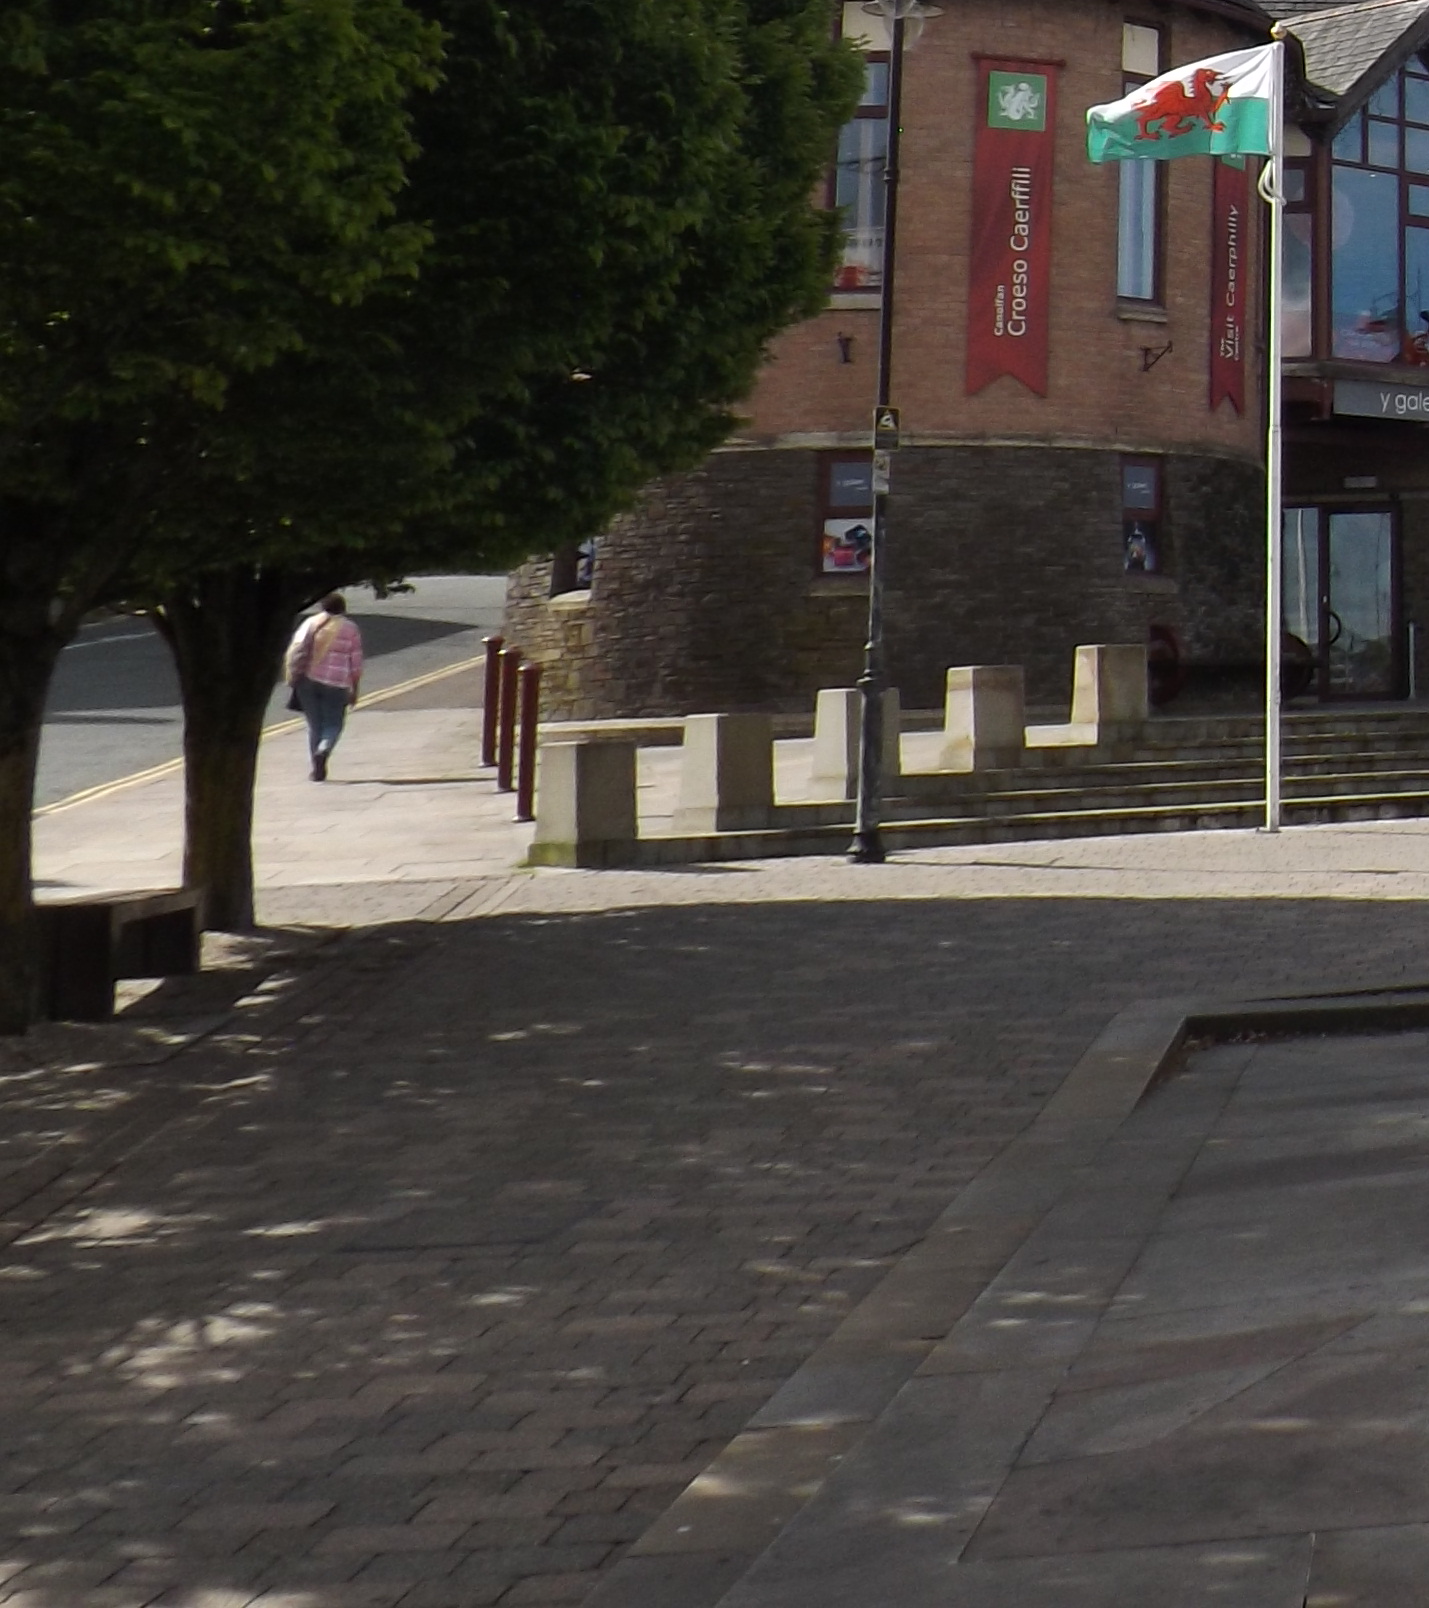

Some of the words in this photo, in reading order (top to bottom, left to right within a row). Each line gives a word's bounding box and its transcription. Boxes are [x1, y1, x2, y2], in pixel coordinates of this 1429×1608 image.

[1010, 167, 1031, 251] Caerffili
[1226, 204, 1239, 306] Caerphilly
[1007, 259, 1027, 336] Croeso
[1225, 315, 1235, 358] Visit
[1380, 392, 1390, 413] y
